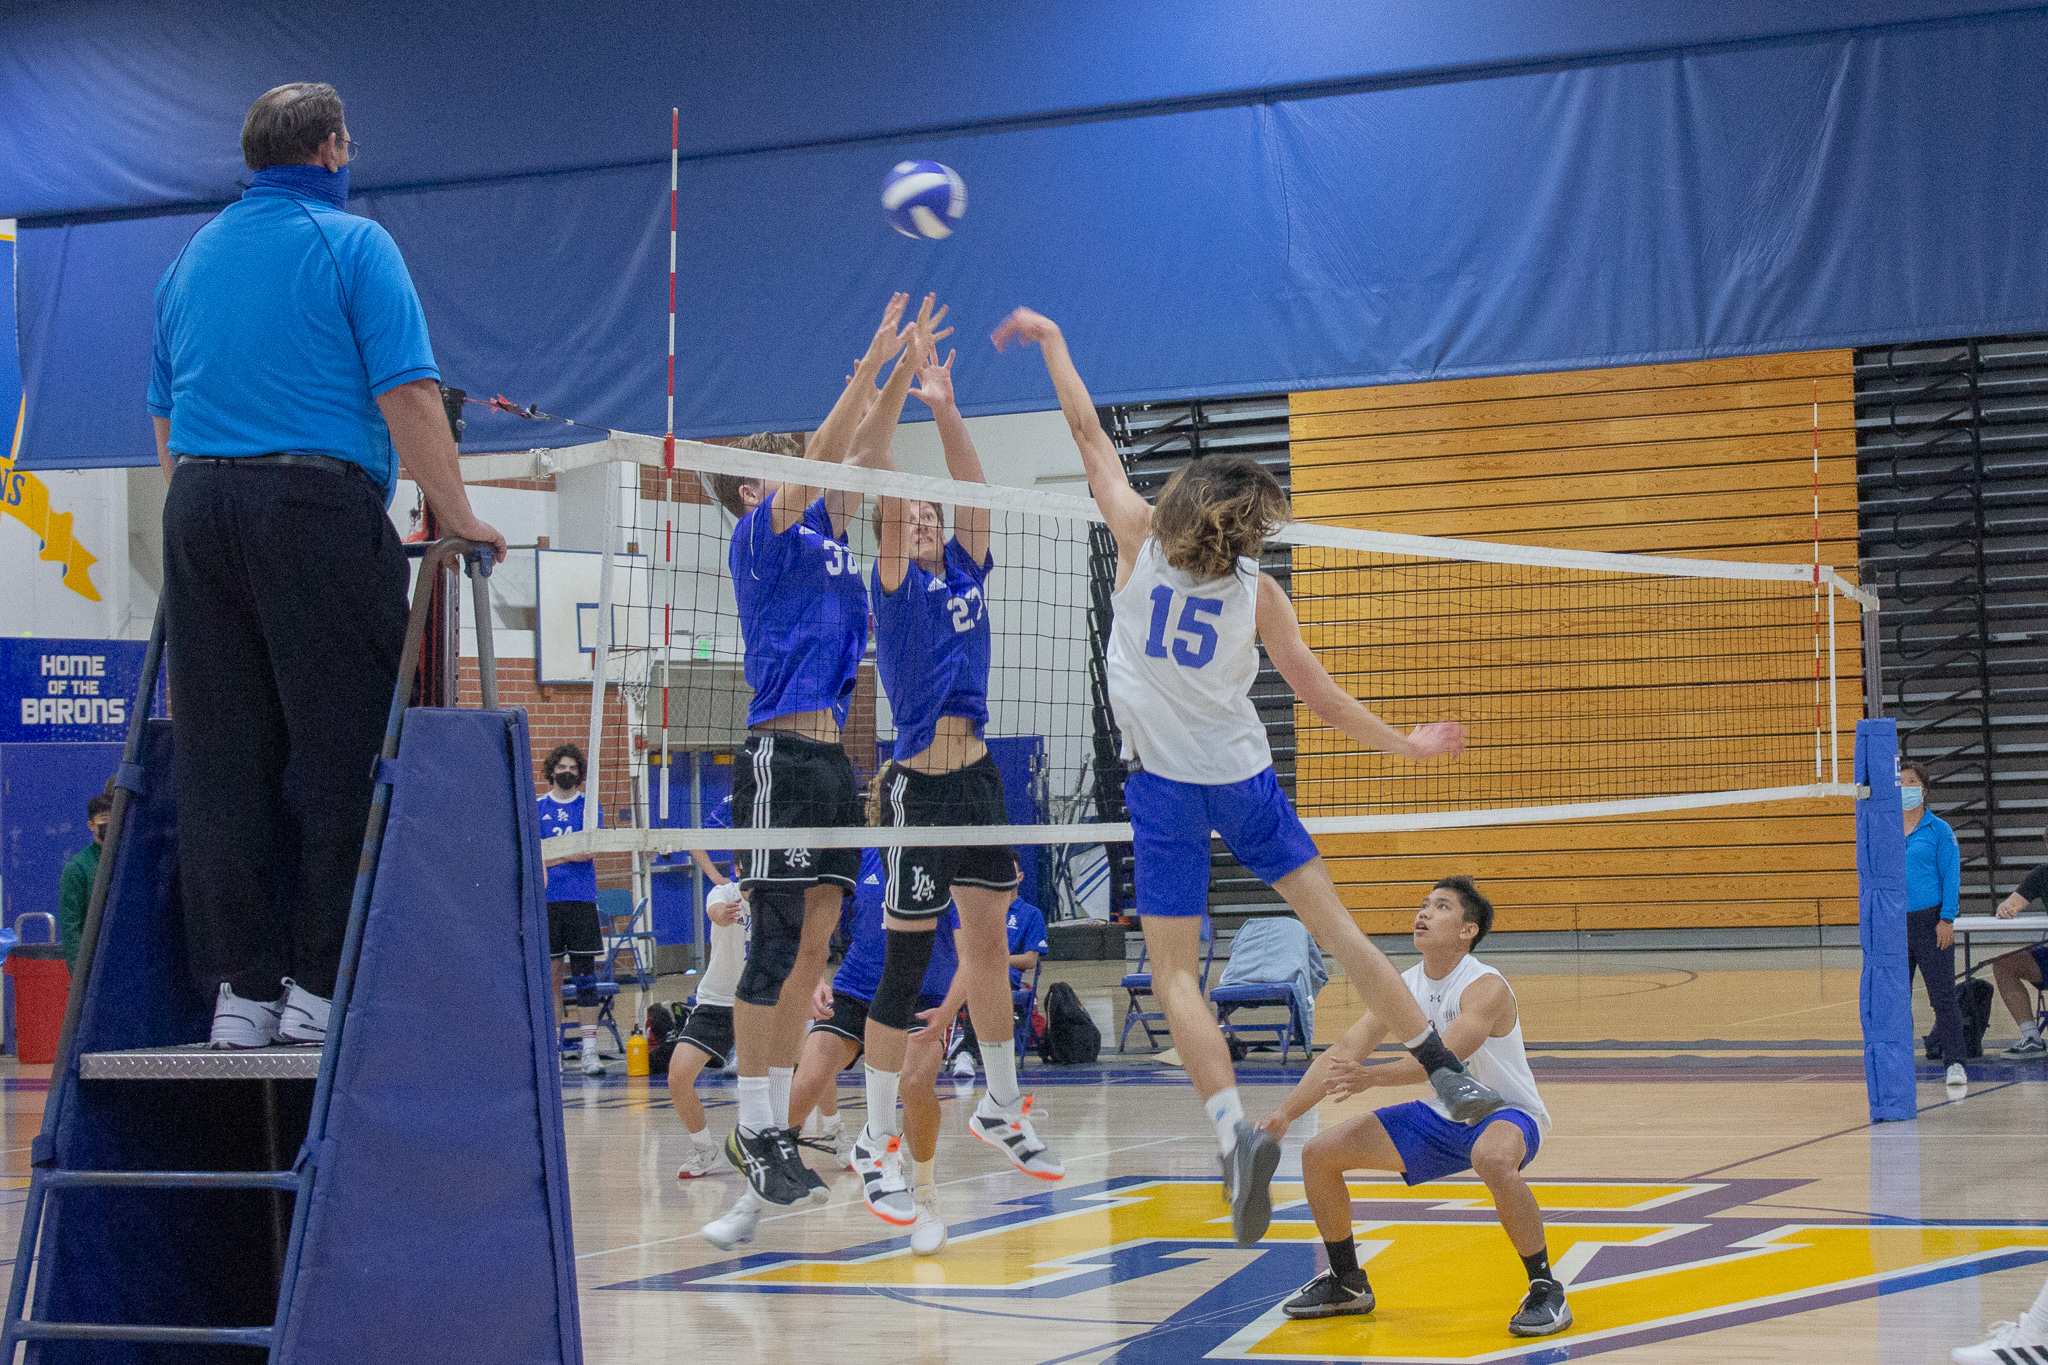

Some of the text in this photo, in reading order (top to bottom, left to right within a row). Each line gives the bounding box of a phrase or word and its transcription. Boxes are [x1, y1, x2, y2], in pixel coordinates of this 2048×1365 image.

[1145, 584, 1224, 669] 15
[41, 655, 106, 676] HOME
[48, 680, 100, 695] OF THE
[21, 698, 125, 725] BARONS
[912, 865, 936, 901] LA
